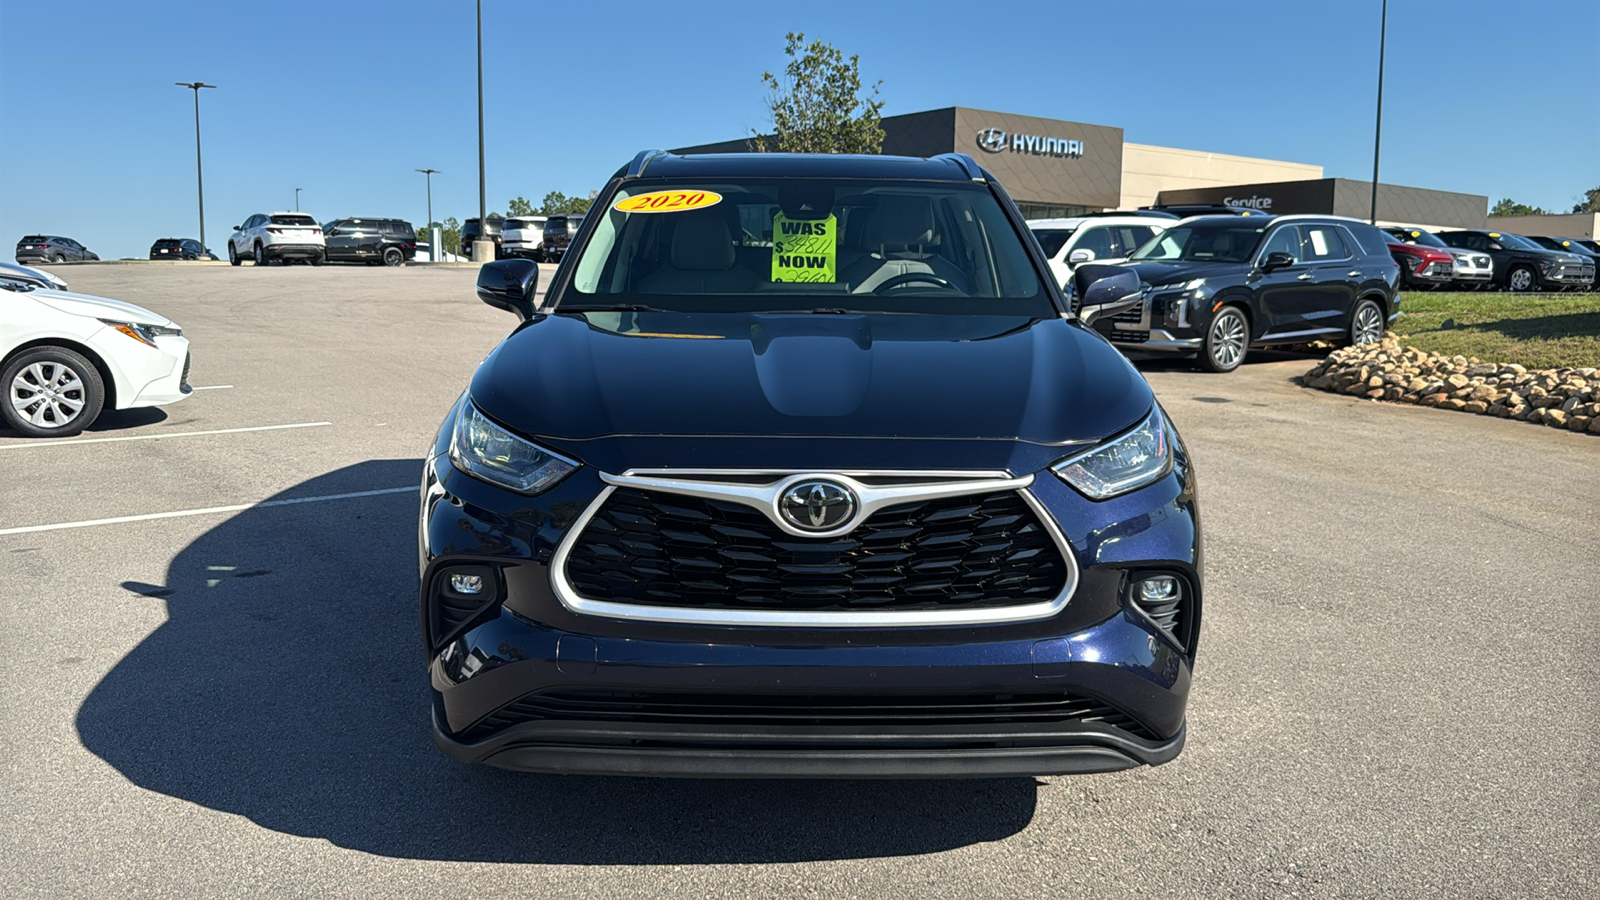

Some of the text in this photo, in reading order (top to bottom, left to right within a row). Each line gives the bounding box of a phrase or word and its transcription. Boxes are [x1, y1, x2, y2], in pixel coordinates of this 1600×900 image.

[1012, 133, 1084, 156] HYUNDAI
[630, 193, 705, 211] 2020
[1223, 195, 1273, 209] Service
[780, 221, 827, 236] WAS
[778, 255, 827, 269] NOW
